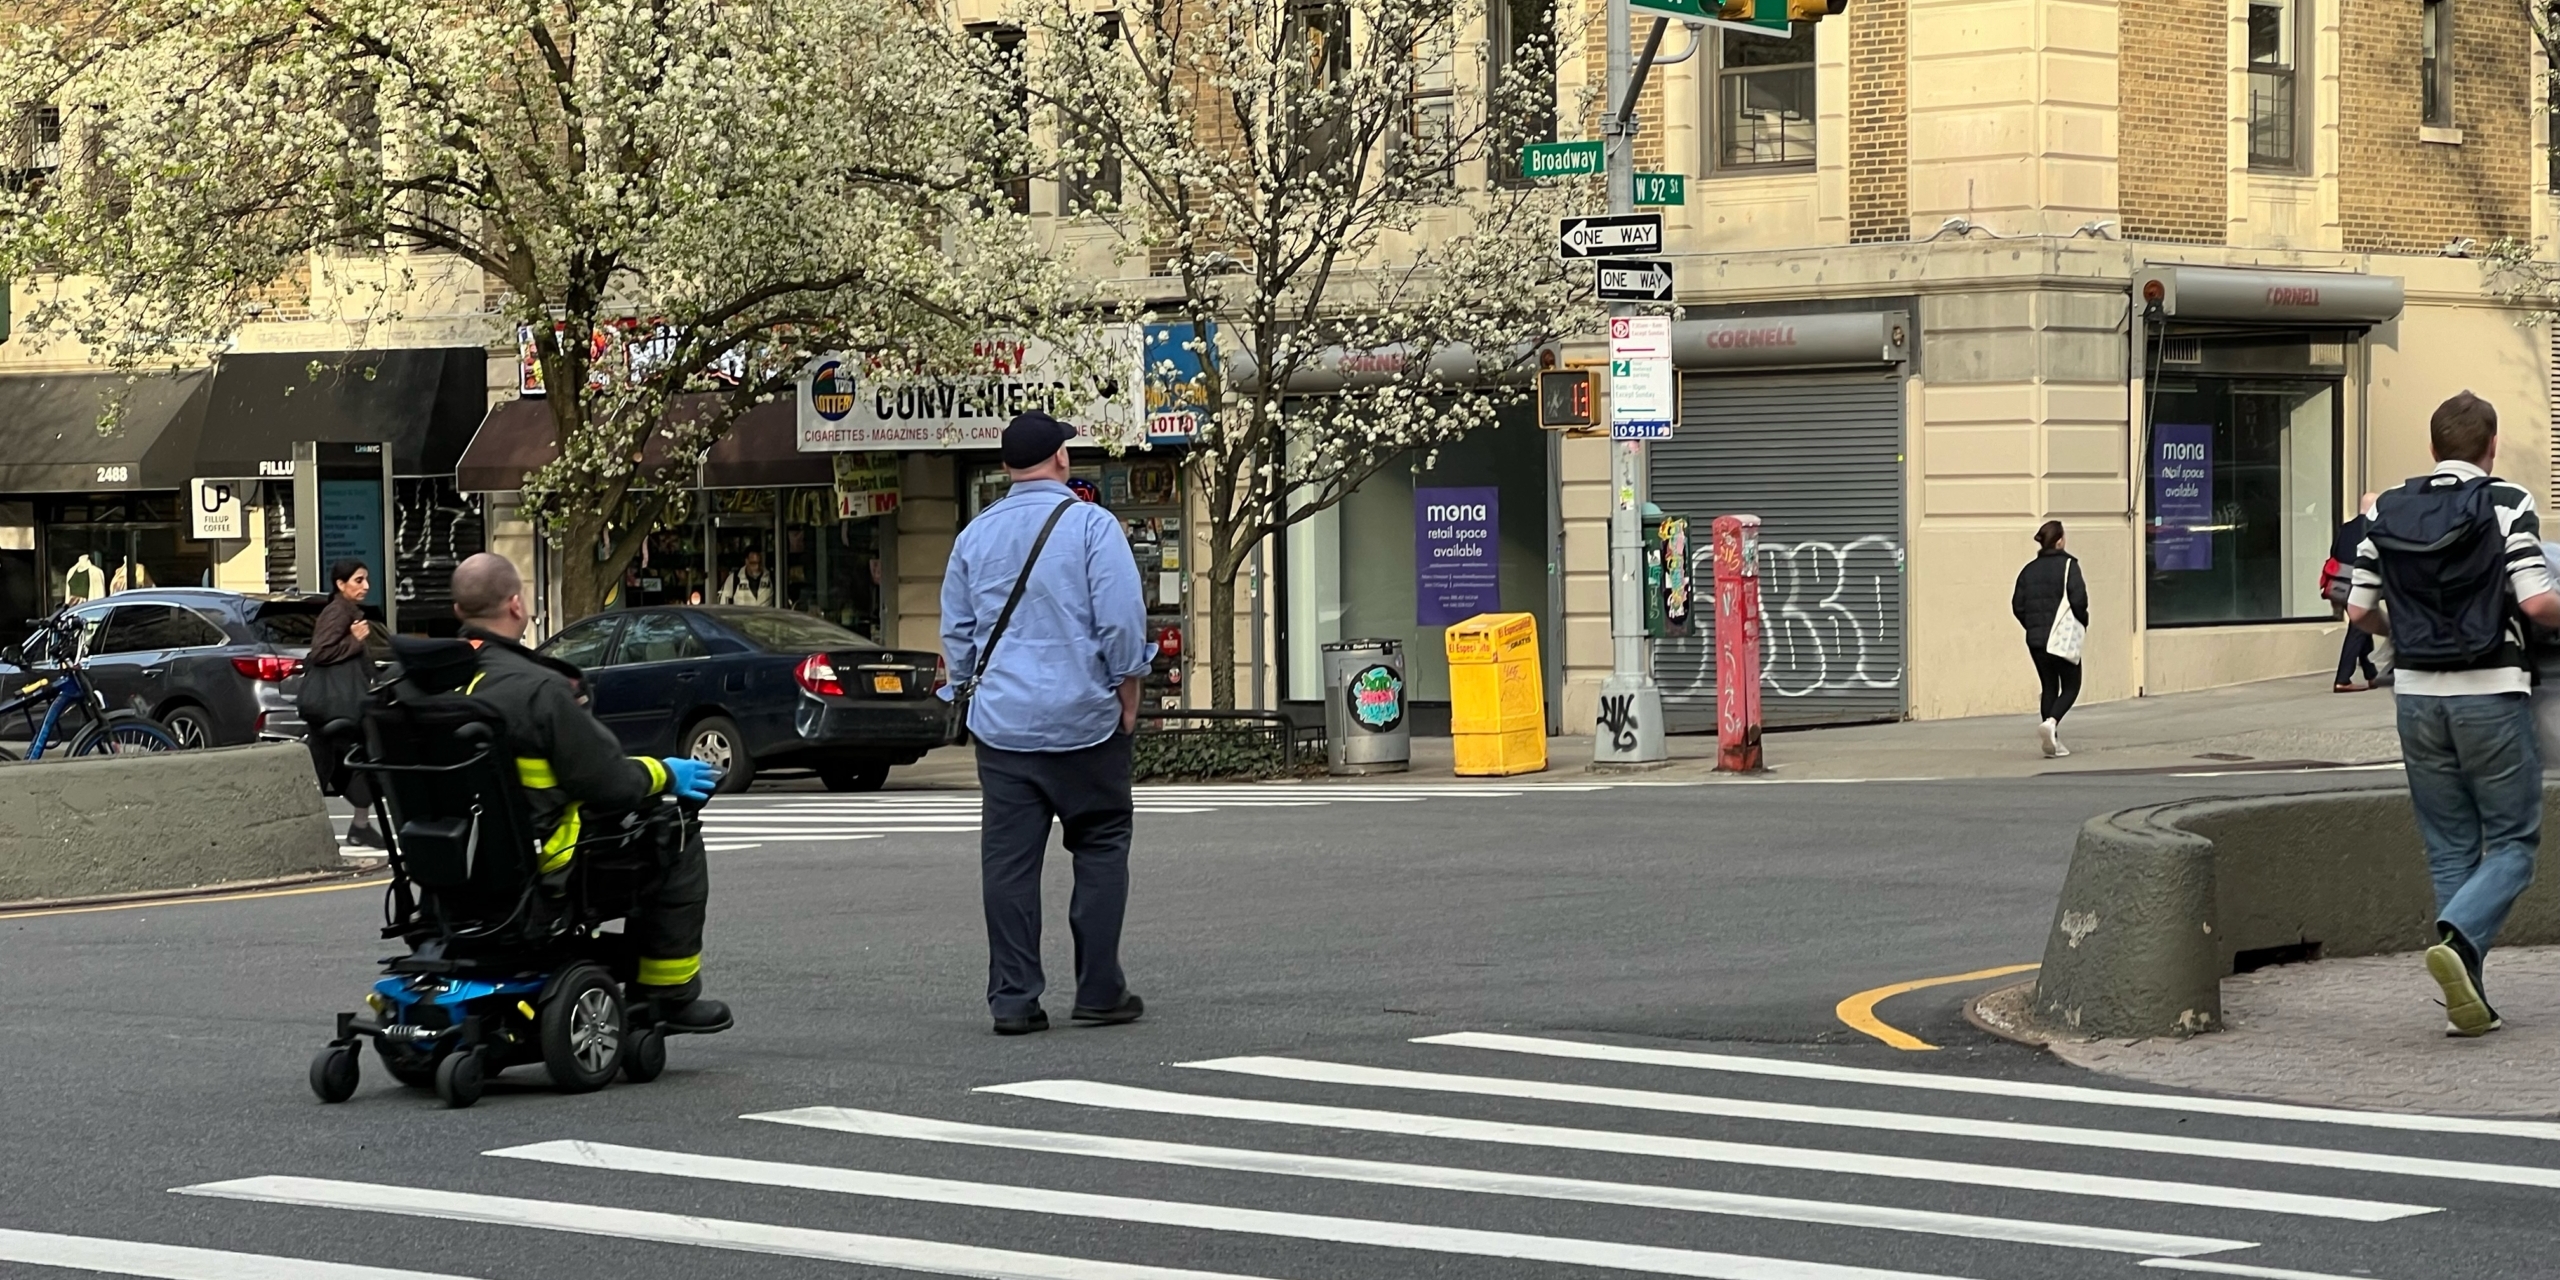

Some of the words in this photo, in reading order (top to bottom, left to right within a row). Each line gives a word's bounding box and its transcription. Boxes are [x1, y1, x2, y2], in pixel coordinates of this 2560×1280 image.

[1532, 149, 1597, 173] Broadway
[1636, 178, 1646, 201] W
[1651, 178, 1666, 202] 92
[1670, 180, 1679, 194] St
[1573, 229, 1604, 246] ONE
[1620, 226, 1653, 243] WAY
[1603, 271, 1628, 287] ONE
[1640, 273, 1664, 288] WAY
[1706, 326, 1797, 349] CORNELL
[1616, 360, 1627, 376] 2
[815, 394, 854, 413] LOTTERY
[1573, 382, 1589, 417] 13
[1151, 415, 1194, 434] LOTTO
[1614, 425, 1656, 437] 109511
[805, 429, 864, 442] CIGARETTES
[872, 428, 928, 441] MAGAZINES
[2162, 443, 2205, 460] mona
[97, 466, 128, 482] 2488
[259, 460, 295, 475] FILLU
[2182, 468, 2205, 481] space
[201, 484, 230, 512] UP
[2165, 482, 2199, 497] available
[204, 515, 229, 523] FILLUP
[1427, 504, 1486, 521] mona
[204, 524, 230, 532] COFFEE
[1428, 525, 1453, 539] retail
[1455, 528, 1488, 542] space
[1433, 543, 1483, 557] available
